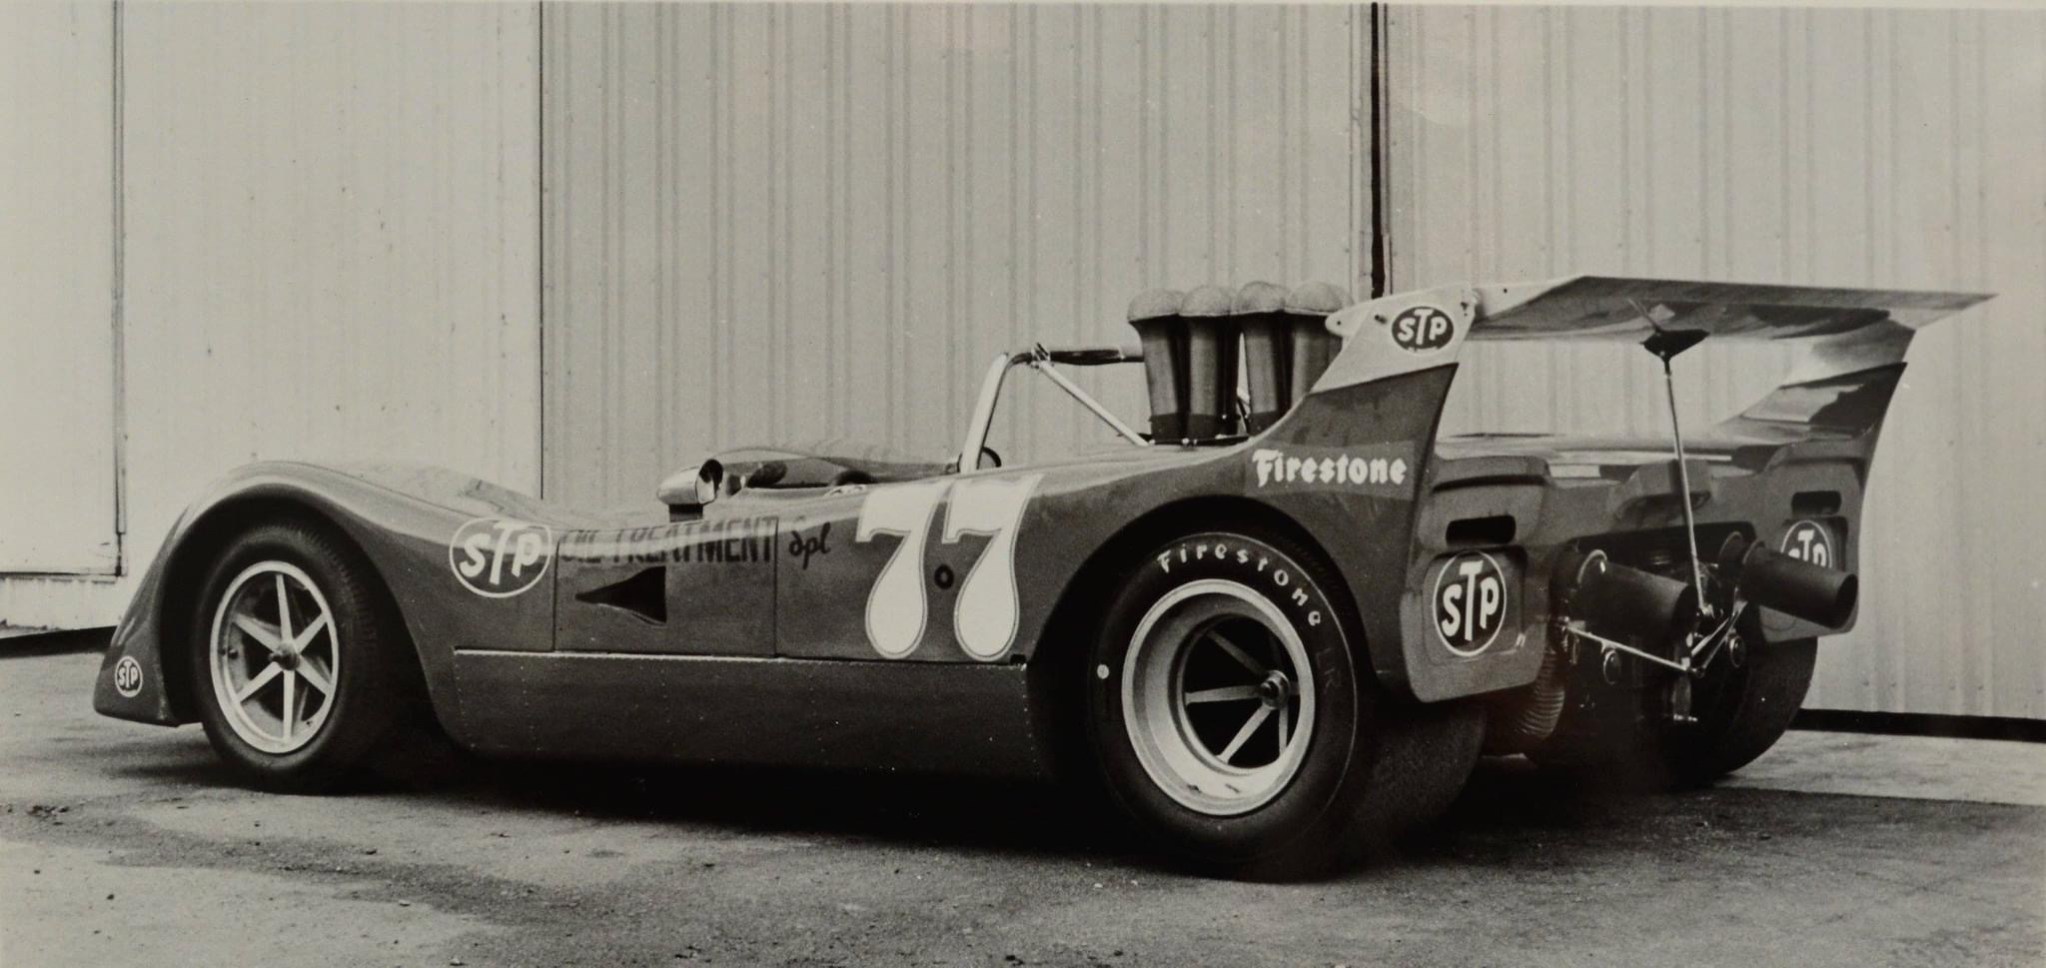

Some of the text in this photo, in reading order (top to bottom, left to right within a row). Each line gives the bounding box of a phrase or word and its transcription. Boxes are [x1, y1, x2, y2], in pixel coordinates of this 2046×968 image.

[1397, 309, 1447, 345] STP
[1252, 449, 1407, 488] Firestone
[459, 520, 541, 586] STP
[855, 473, 1044, 662] 77
[1157, 543, 1321, 626] Firestone
[1441, 560, 1500, 641] STP
[118, 661, 139, 688] STP
